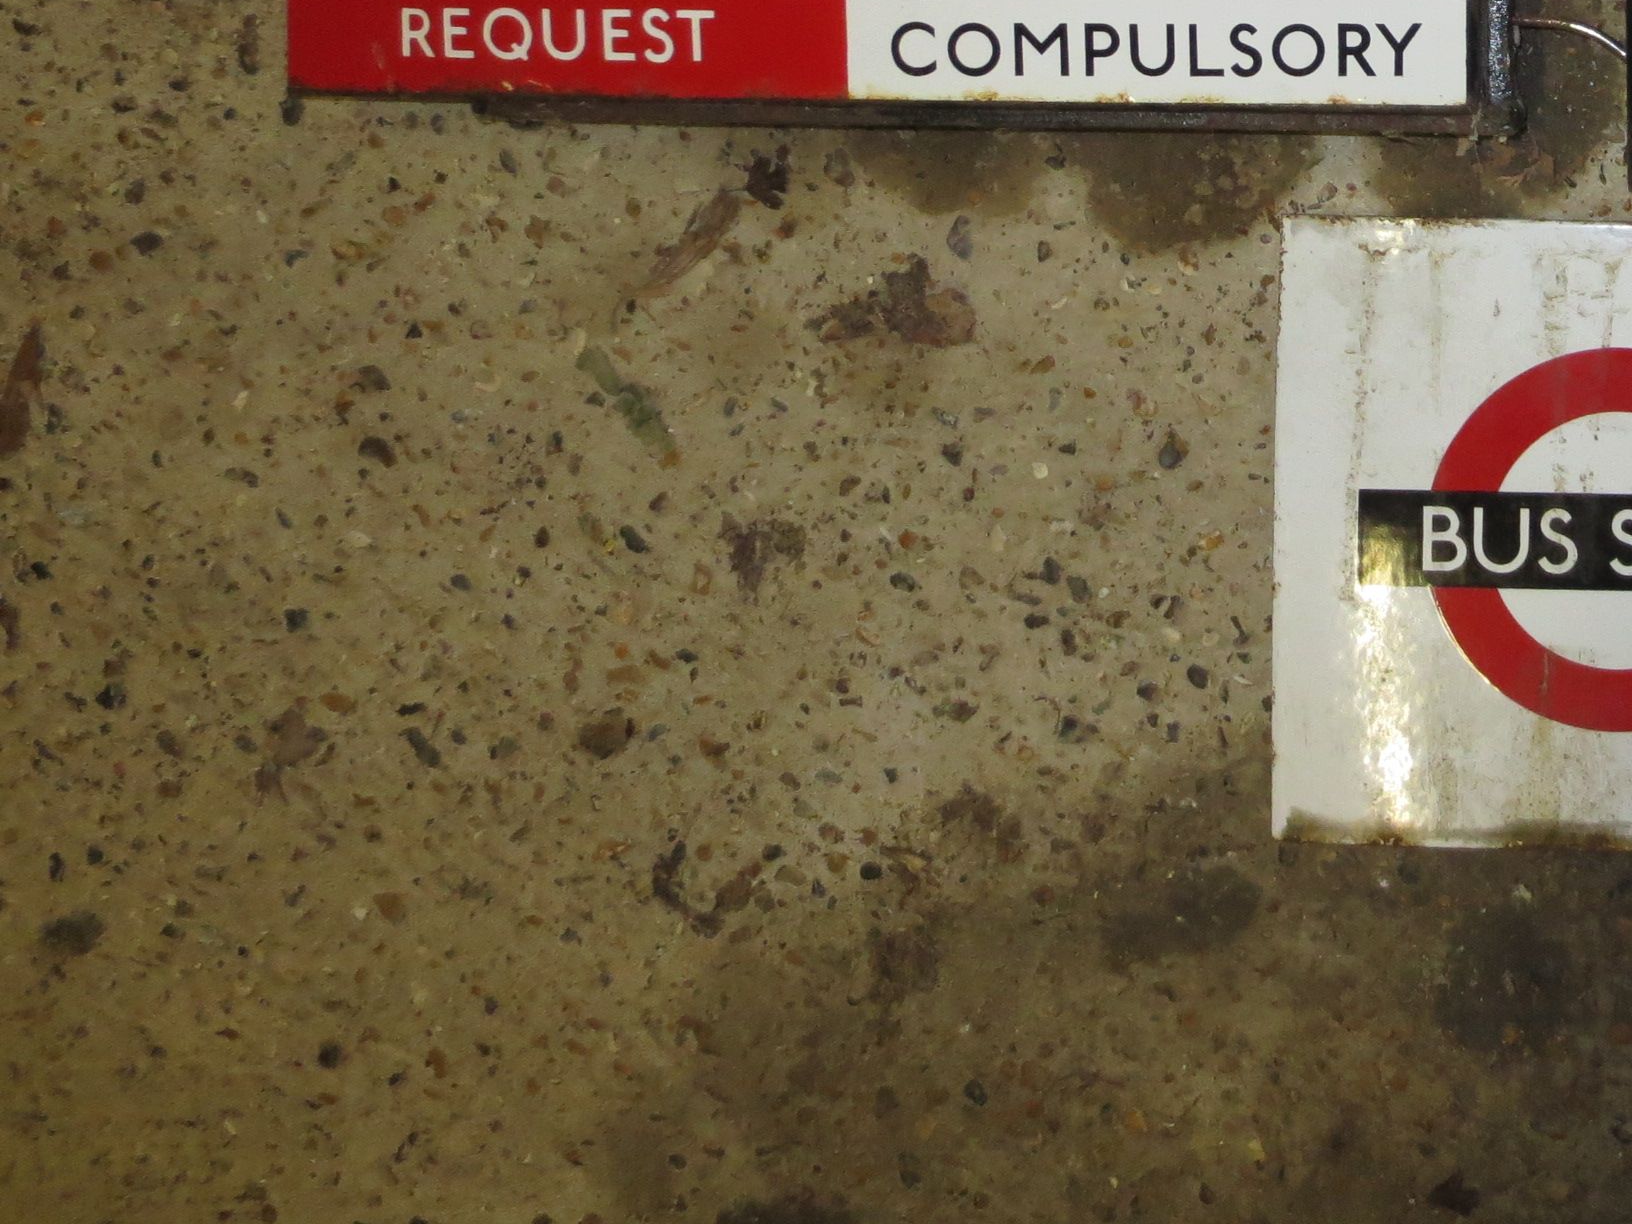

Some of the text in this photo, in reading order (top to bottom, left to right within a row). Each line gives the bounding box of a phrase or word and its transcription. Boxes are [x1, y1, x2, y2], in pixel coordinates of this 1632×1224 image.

[399, 6, 716, 66] REQUEST
[890, 20, 1424, 79] COMPULSORY
[1421, 504, 1579, 576] BUS
